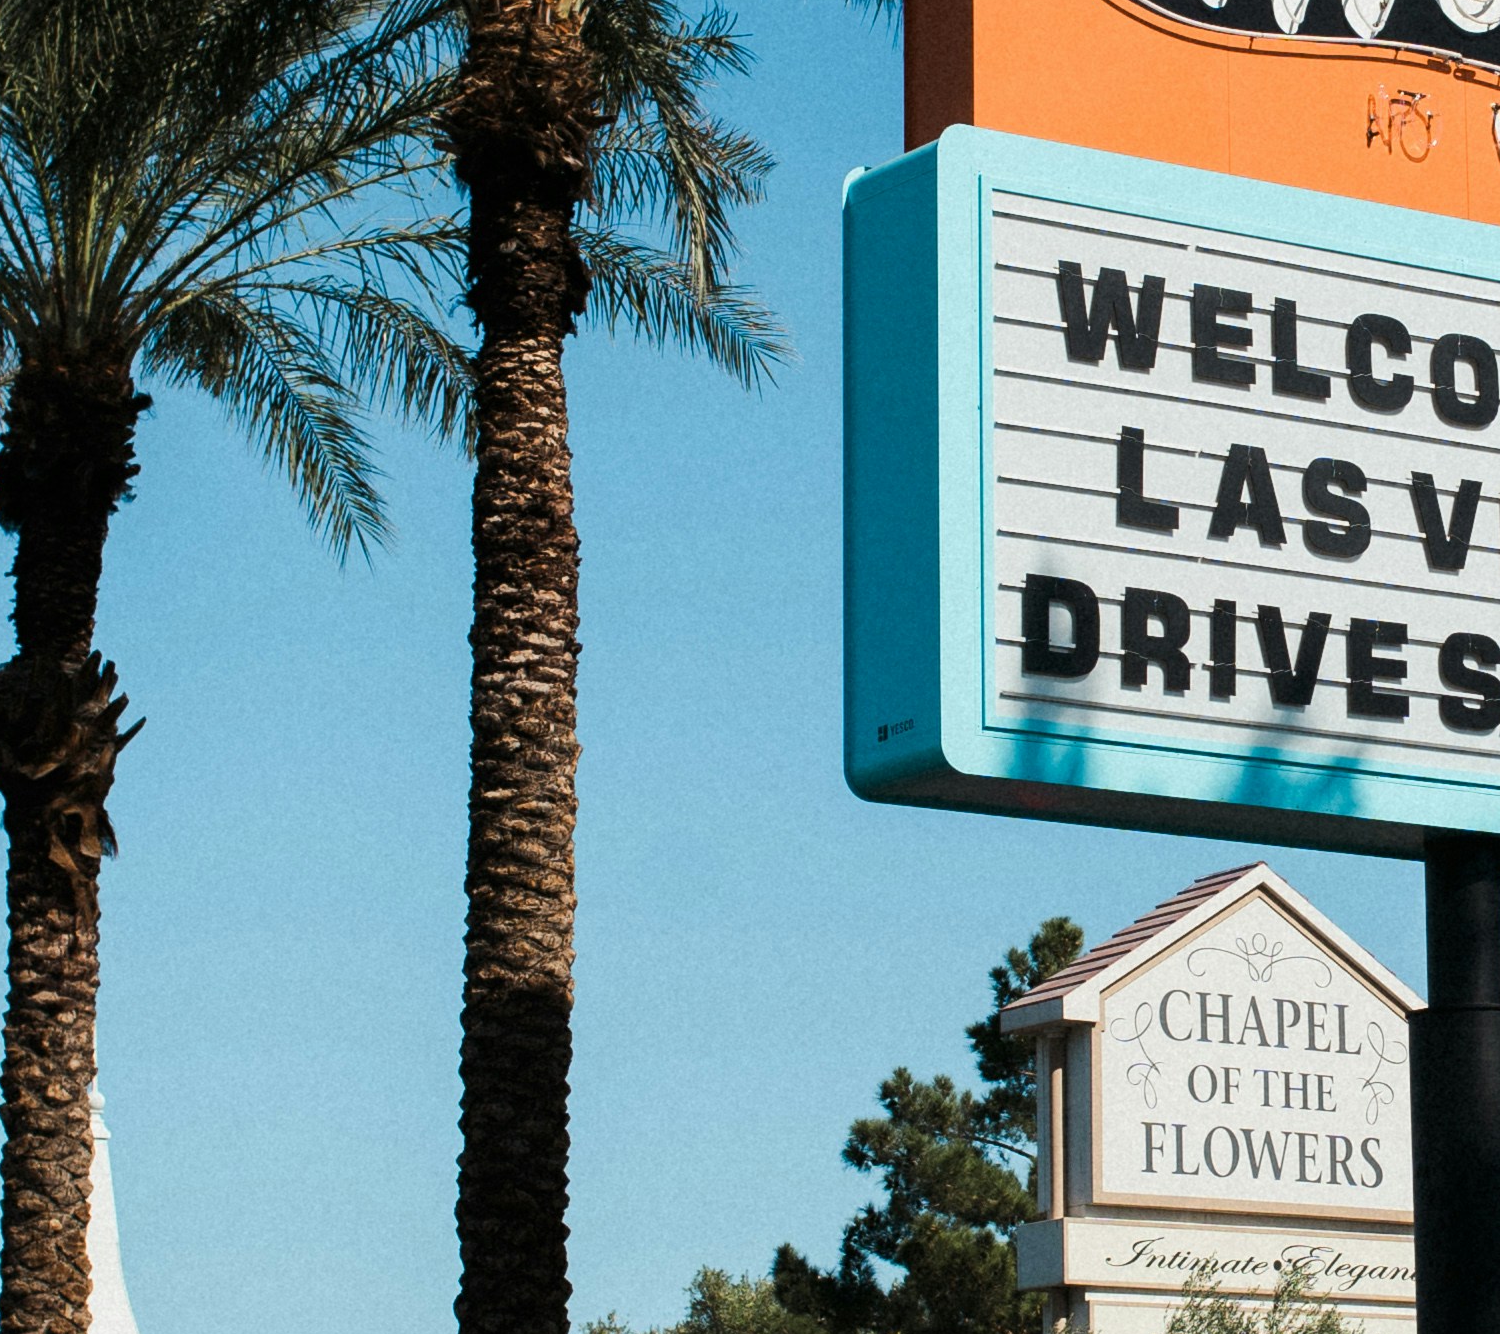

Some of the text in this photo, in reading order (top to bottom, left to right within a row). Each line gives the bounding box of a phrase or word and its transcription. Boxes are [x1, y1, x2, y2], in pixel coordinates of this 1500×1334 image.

[1117, 425, 1372, 560] LAS
[890, 718, 914, 736] YESCO
[1159, 989, 1362, 1056] CHAPEL
[1187, 1064, 1337, 1113] OF THE
[1141, 1121, 1384, 1189] FLOWERS
[1106, 1237, 1416, 1291] Intimate Elegan
